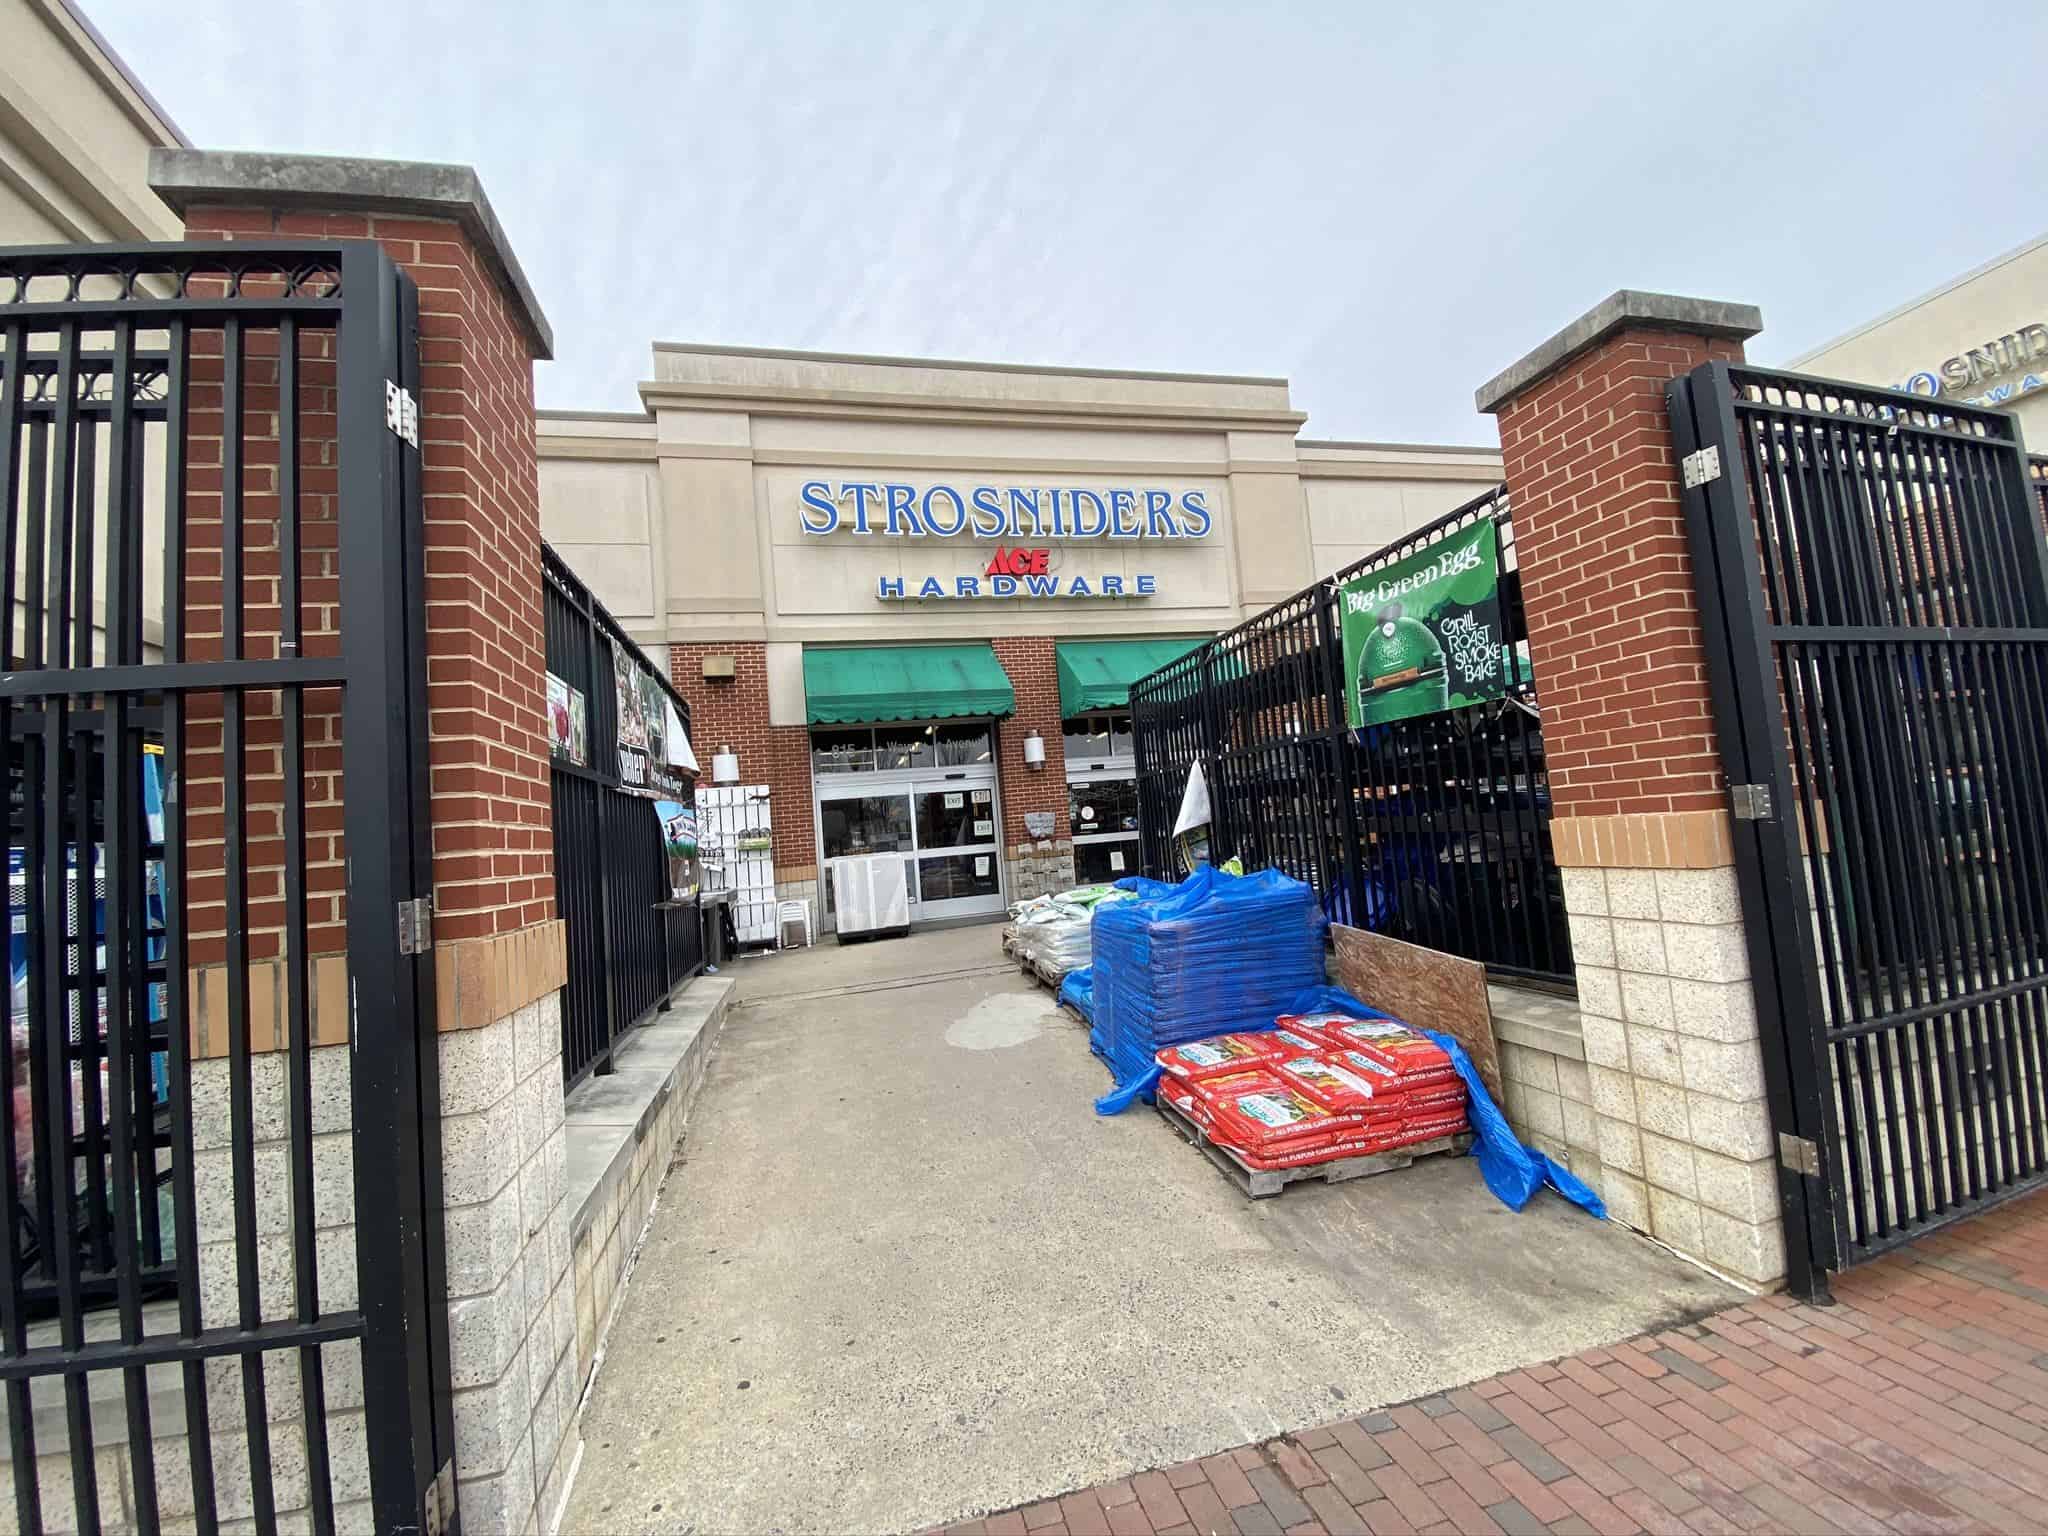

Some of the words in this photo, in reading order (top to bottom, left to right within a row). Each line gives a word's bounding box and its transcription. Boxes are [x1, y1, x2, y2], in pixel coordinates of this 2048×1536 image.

[1889, 323, 2048, 396] OSNID
[801, 481, 1211, 538] STROSNIDERS
[984, 544, 1050, 577] ACE
[878, 575, 1159, 598] HARDWARE
[1347, 590, 1376, 615] Big
[1378, 562, 1437, 602] Green
[1441, 609, 1479, 636] GRILL
[1448, 624, 1491, 654] ROAST
[1455, 641, 1501, 671] SMOKE
[1465, 660, 1497, 683] BAKE
[831, 744, 856, 759] 815
